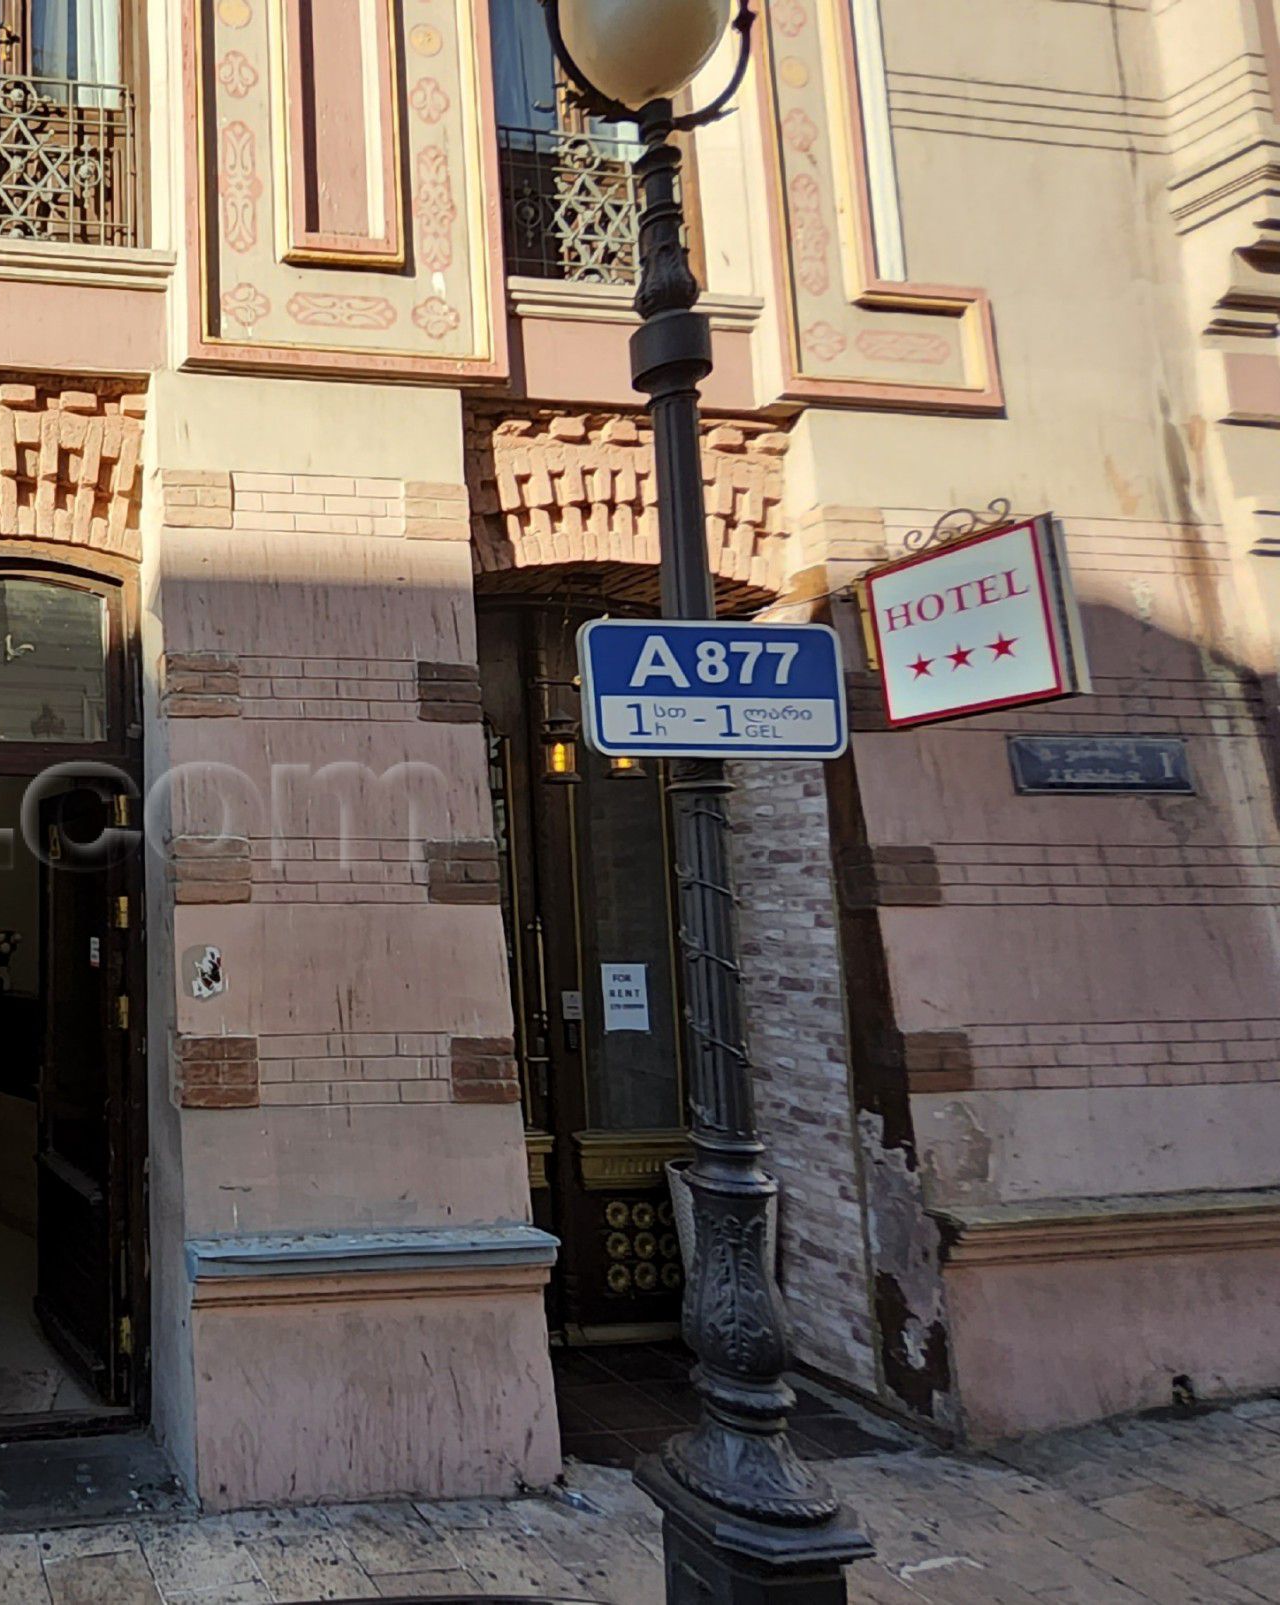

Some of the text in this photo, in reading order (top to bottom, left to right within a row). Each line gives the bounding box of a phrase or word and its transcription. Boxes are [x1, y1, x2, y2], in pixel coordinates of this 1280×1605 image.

[884, 568, 1031, 633] HOTEL
[629, 635, 799, 688] A 877
[627, 703, 652, 736] 1
[716, 704, 741, 738] 1
[745, 724, 783, 739] GEL
[612, 973, 632, 982] FOR
[609, 989, 640, 998] RENT
